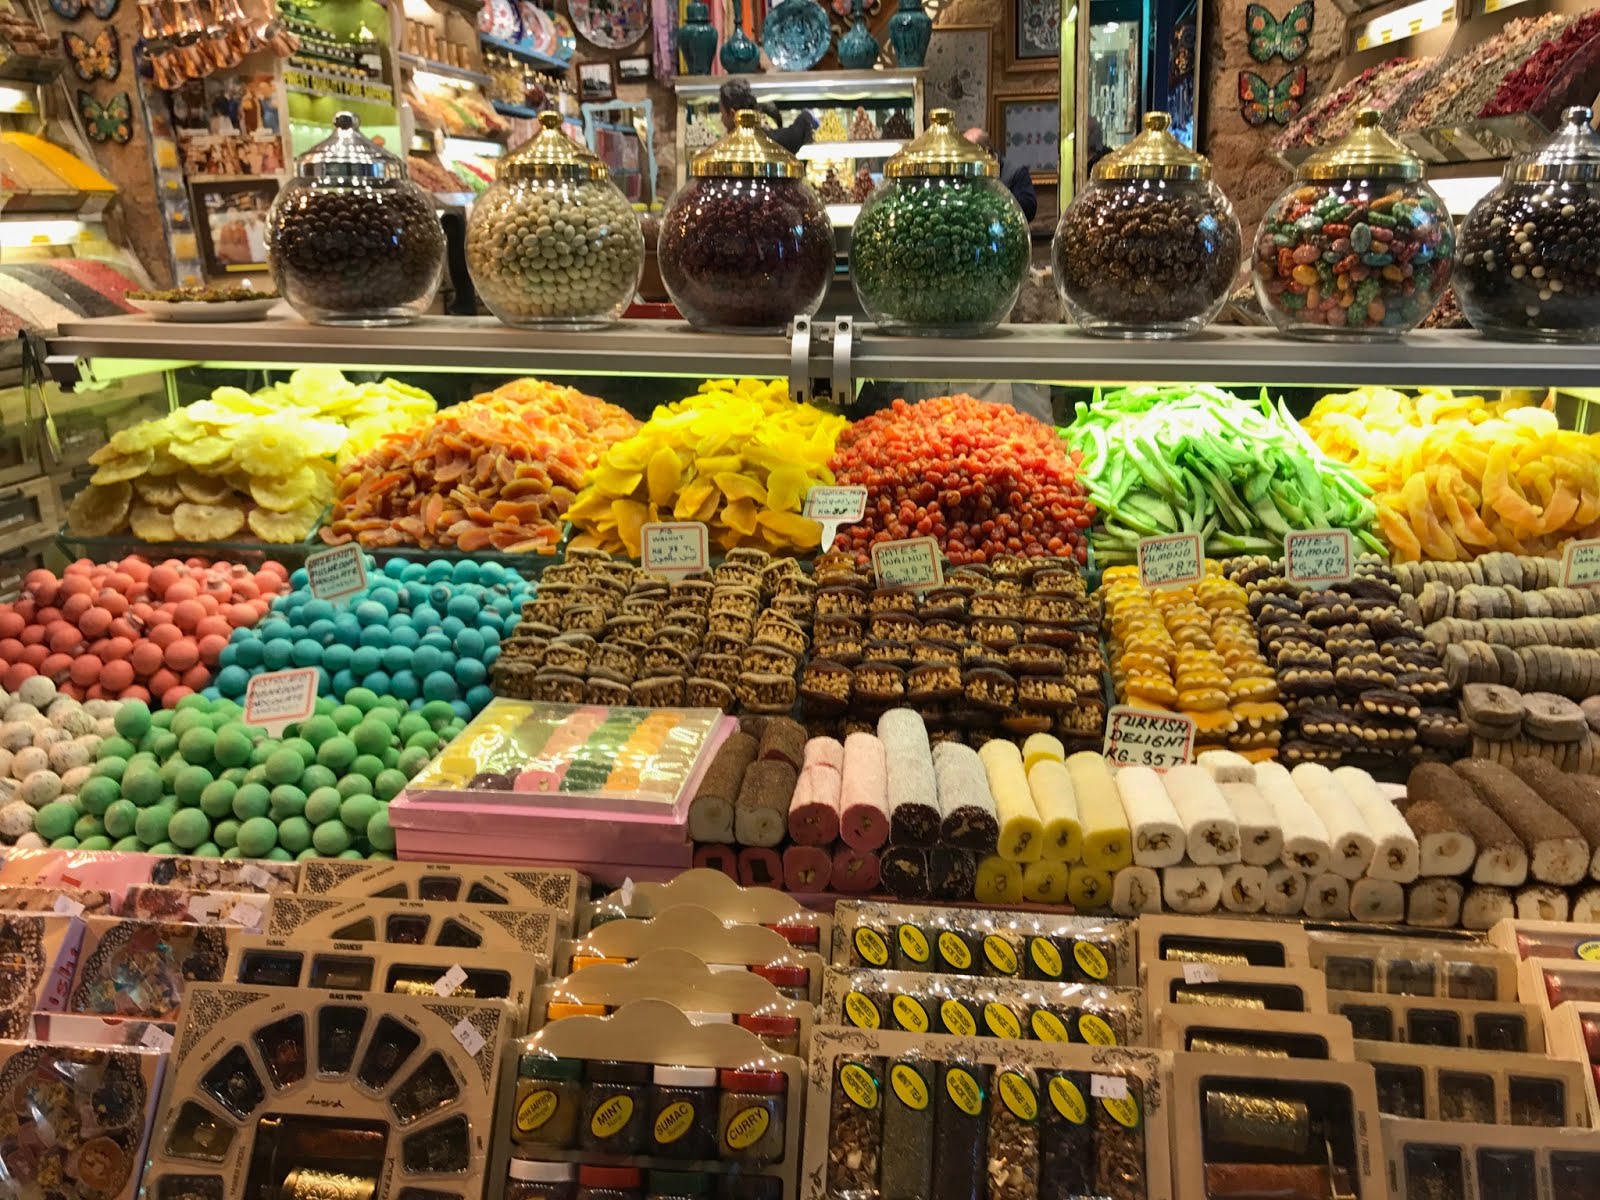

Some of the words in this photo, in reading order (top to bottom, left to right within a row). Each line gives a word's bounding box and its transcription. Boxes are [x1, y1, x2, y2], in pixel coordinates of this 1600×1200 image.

[882, 553, 929, 566] WALNUT
[1144, 548, 1190, 563] ALMOND
[1291, 545, 1340, 558] ALMOND
[1111, 712, 1188, 733] TURKISH
[1142, 750, 1166, 766] 35
[333, 943, 363, 951] CORIANDER
[903, 929, 915, 943] MINT
[914, 944, 924, 956] TEA
[872, 951, 882, 963] TEA
[954, 955, 964, 966] TEA
[985, 937, 1006, 961] ORANGE
[1005, 959, 1015, 971] TEA
[863, 1017, 873, 1029] TEA
[897, 1000, 912, 1016] MINT
[911, 1015, 922, 1028] TEA
[986, 1004, 1008, 1028] ORANGE
[1006, 1026, 1018, 1039] TEA
[896, 1070, 911, 1089] MINT
[910, 1087, 922, 1103] TEA
[861, 1092, 872, 1106] TEA
[964, 1097, 974, 1111] TEA
[1001, 1075, 1025, 1104] ORANGE
[1023, 1101, 1034, 1117] TEA
[597, 1100, 623, 1127] MINT
[655, 1104, 688, 1136] SUMAC
[729, 1109, 762, 1140] CURRY
